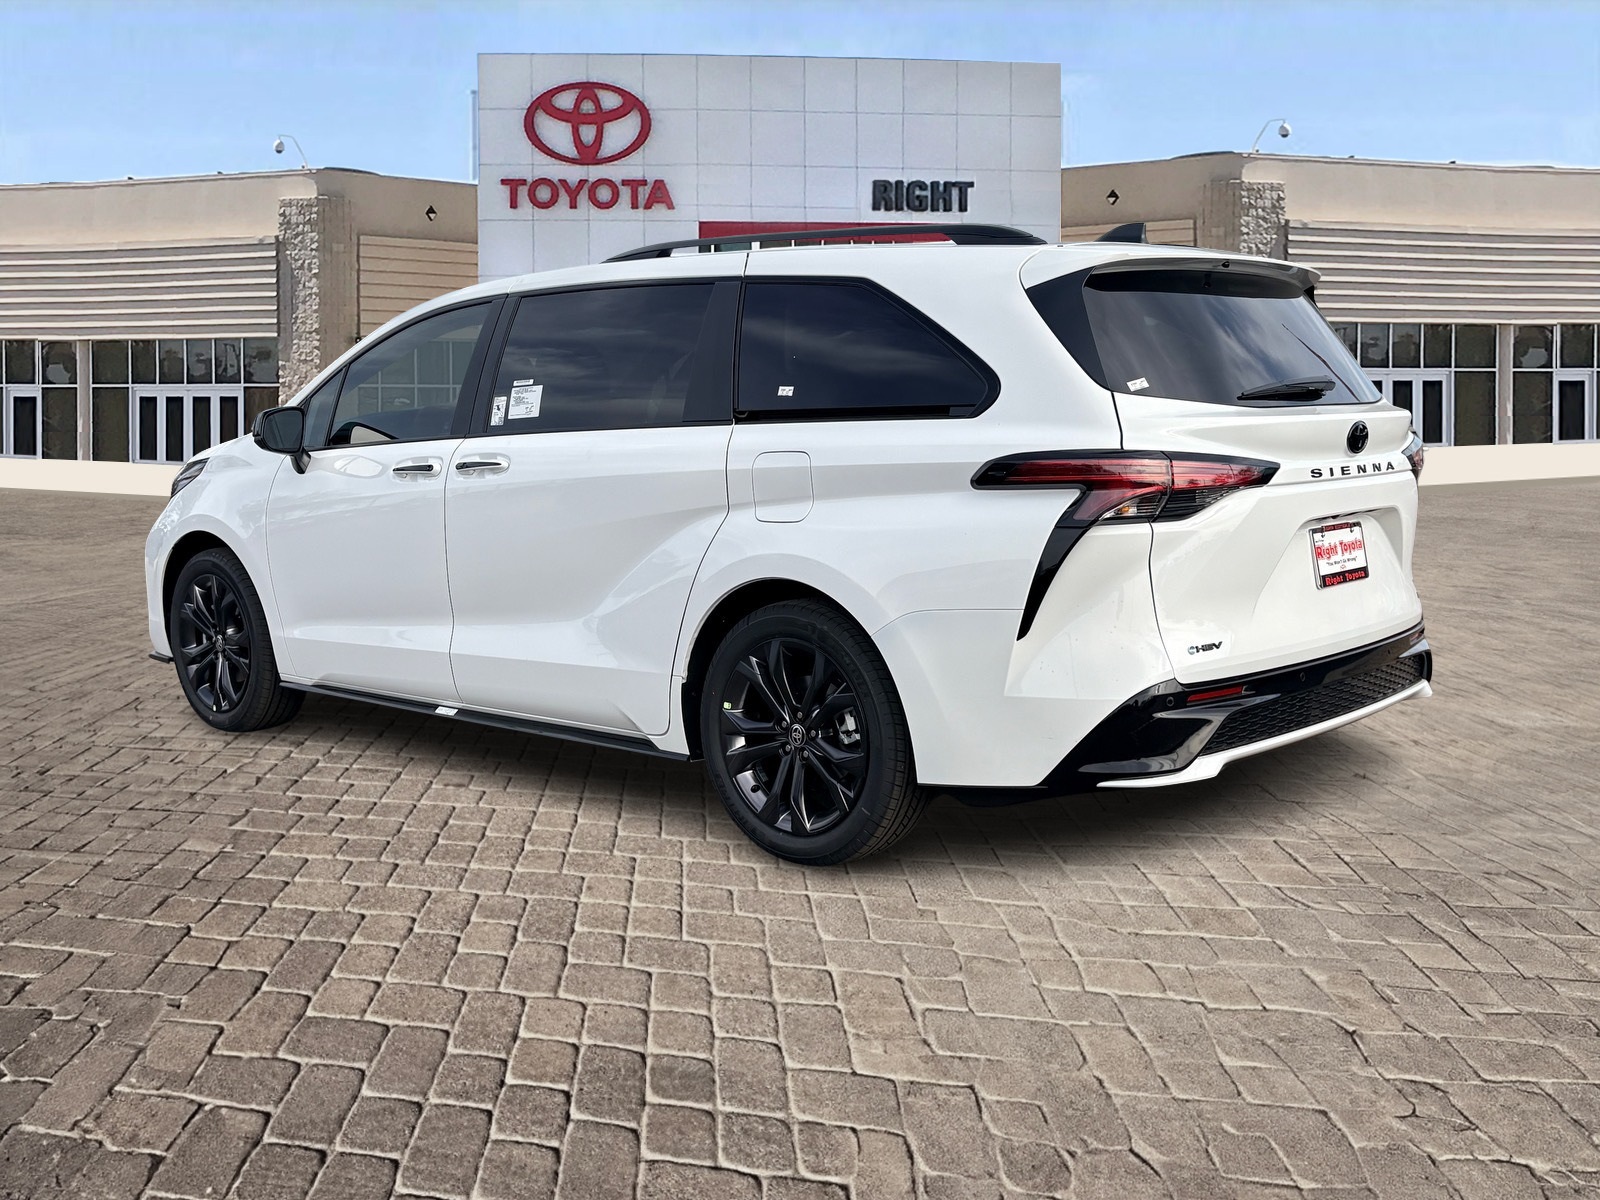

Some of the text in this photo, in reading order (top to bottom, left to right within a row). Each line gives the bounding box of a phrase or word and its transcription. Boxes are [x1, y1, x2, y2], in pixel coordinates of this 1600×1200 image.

[500, 178, 675, 210] TOYOTA
[872, 179, 975, 213] RIGHT
[1310, 461, 1395, 478] SIENNA
[1316, 539, 1362, 559] Right Toyota
[1325, 571, 1365, 585] Right Toyota
